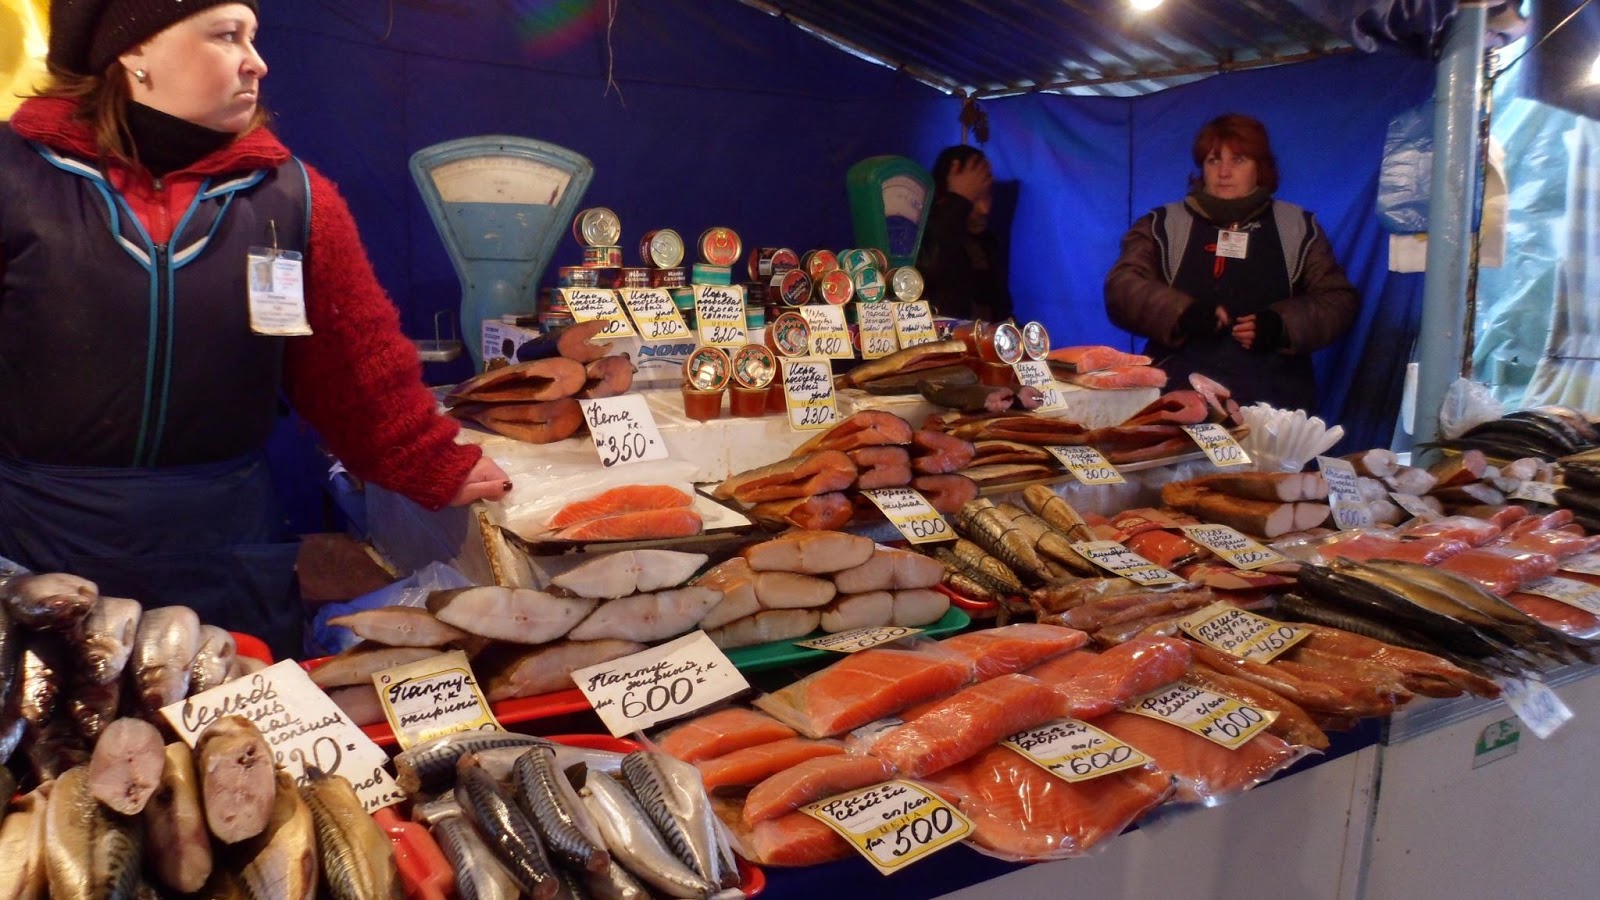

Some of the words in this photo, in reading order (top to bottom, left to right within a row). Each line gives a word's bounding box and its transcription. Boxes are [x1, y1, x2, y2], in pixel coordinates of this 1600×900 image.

[911, 517, 946, 538] 600
[1214, 706, 1264, 738] 600
[1070, 745, 1132, 775] 600
[351, 767, 384, 793] лов
[893, 806, 953, 857] 500
